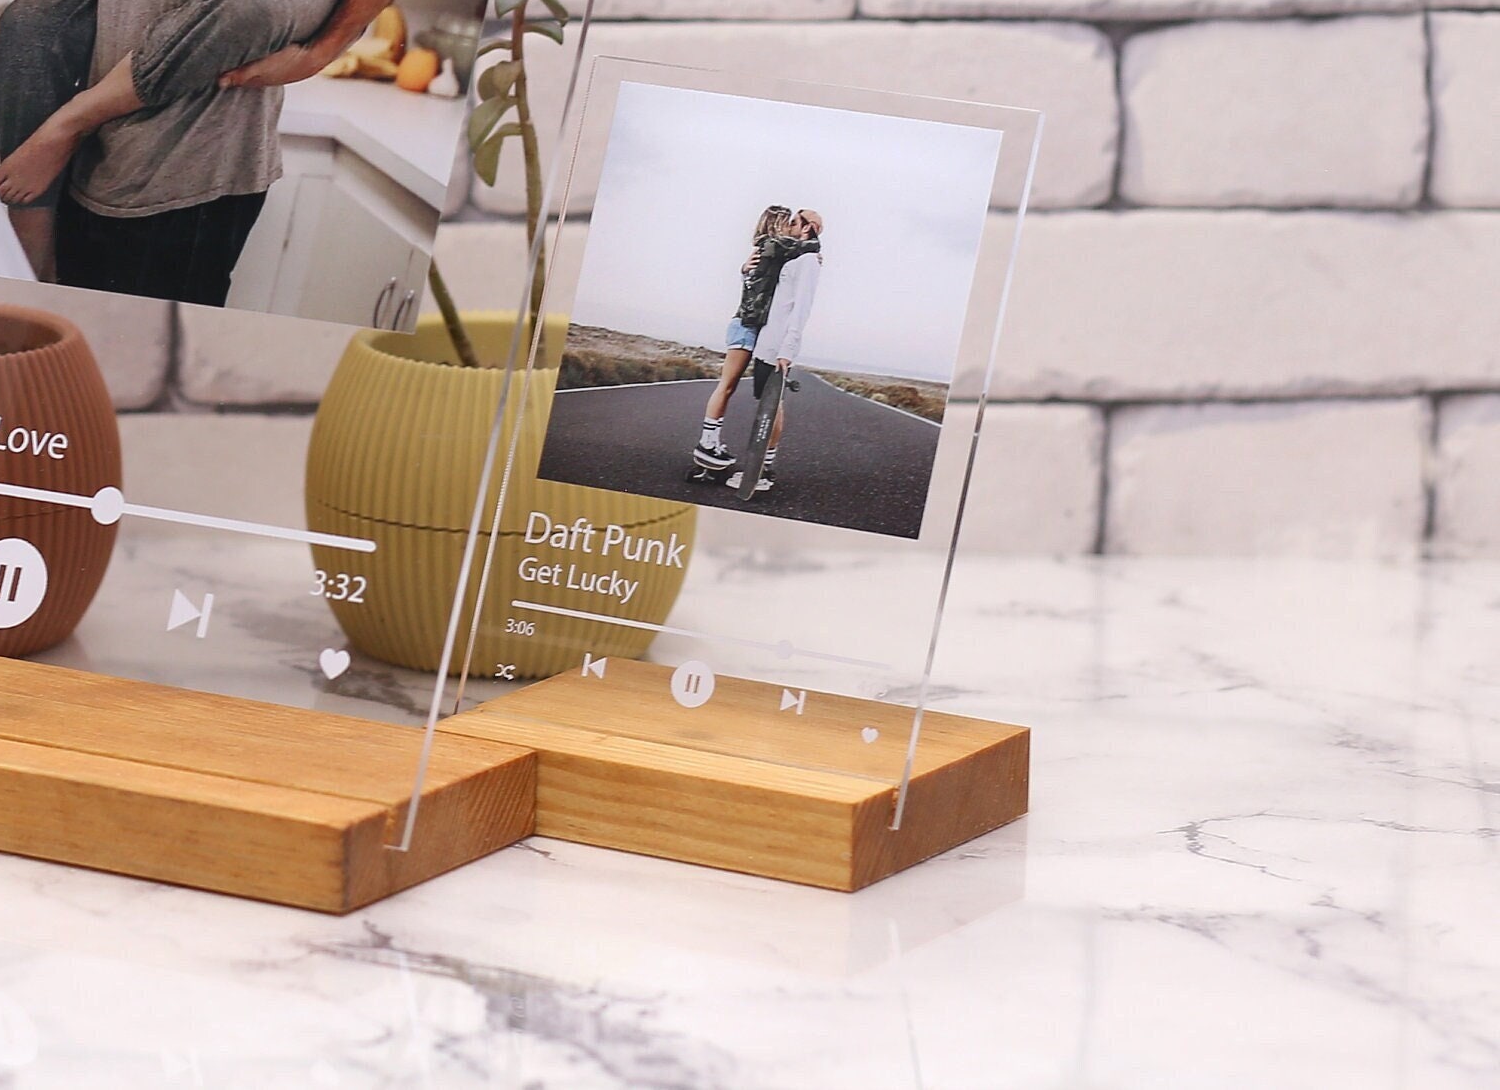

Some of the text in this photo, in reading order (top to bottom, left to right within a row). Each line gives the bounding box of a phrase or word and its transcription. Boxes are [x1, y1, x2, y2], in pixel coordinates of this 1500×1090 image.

[524, 511, 688, 569] Daft Punk
[308, 569, 368, 605] 3:32
[518, 556, 639, 605] Get Lucky
[505, 617, 535, 637] 3:06
